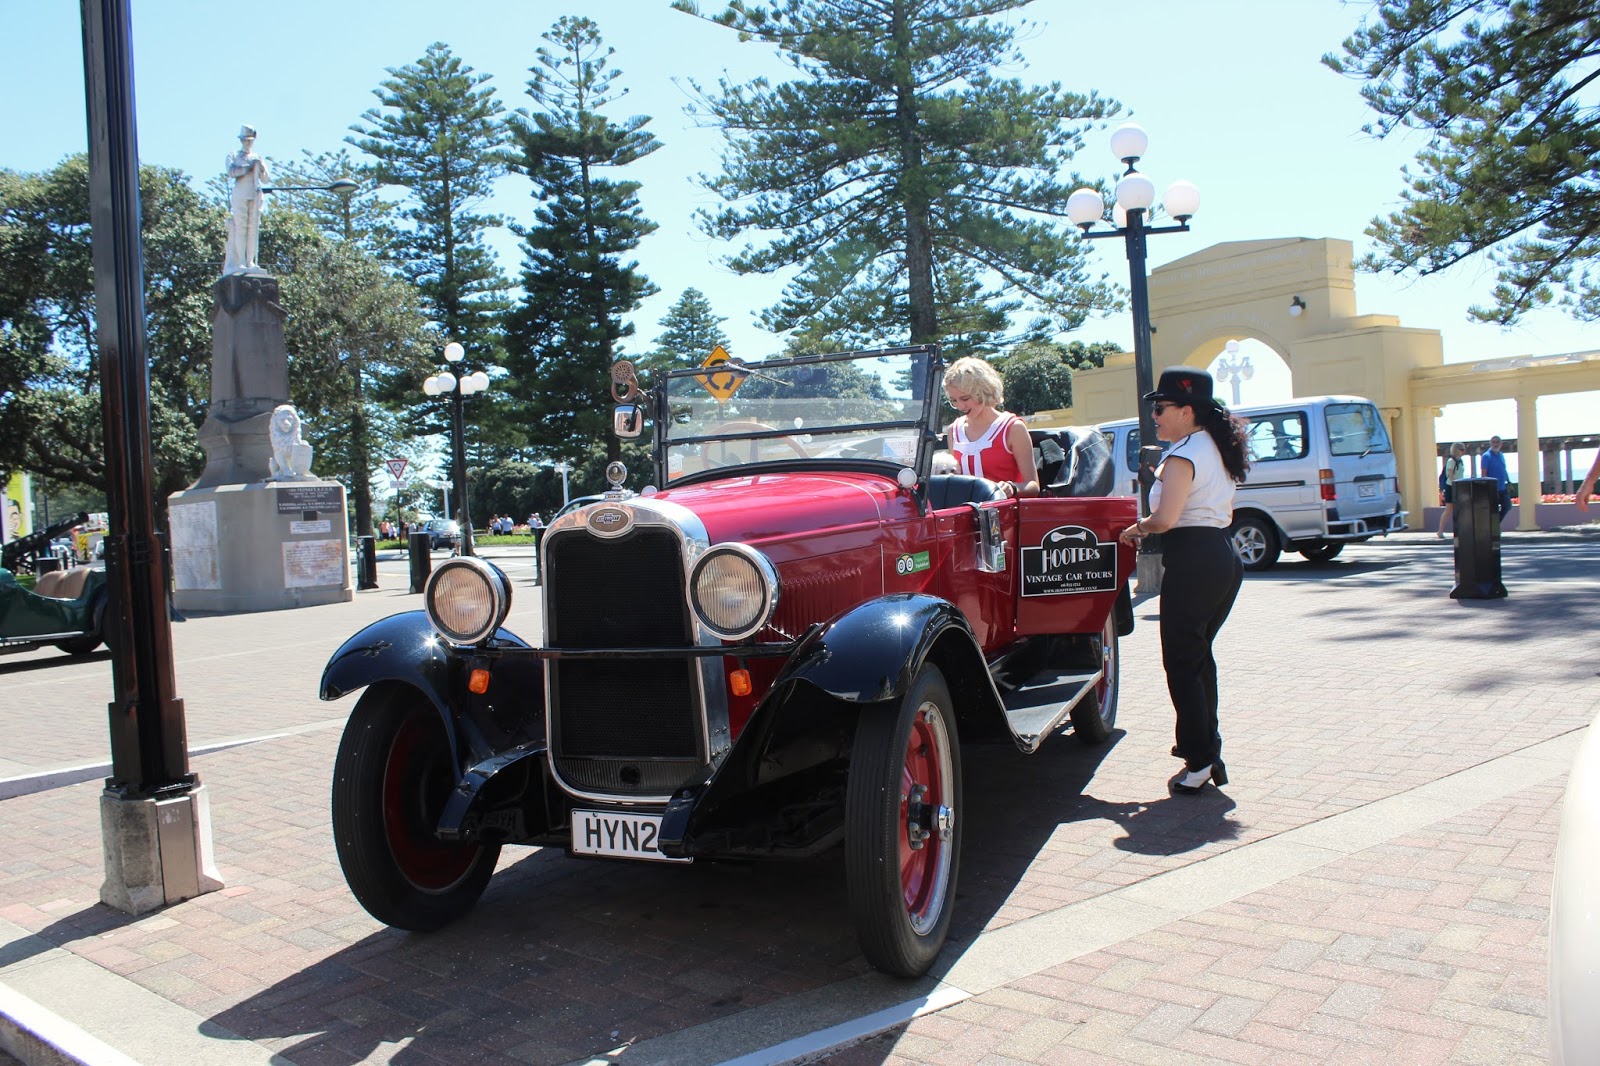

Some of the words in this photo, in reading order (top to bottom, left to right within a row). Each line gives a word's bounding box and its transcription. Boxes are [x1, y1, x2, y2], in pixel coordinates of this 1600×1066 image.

[1042, 547, 1100, 574] HOOTERS
[1026, 574, 1063, 583] VINTAGE
[1066, 572, 1082, 581] CAR
[1085, 571, 1113, 580] TOURS
[585, 817, 658, 853] HYN2
